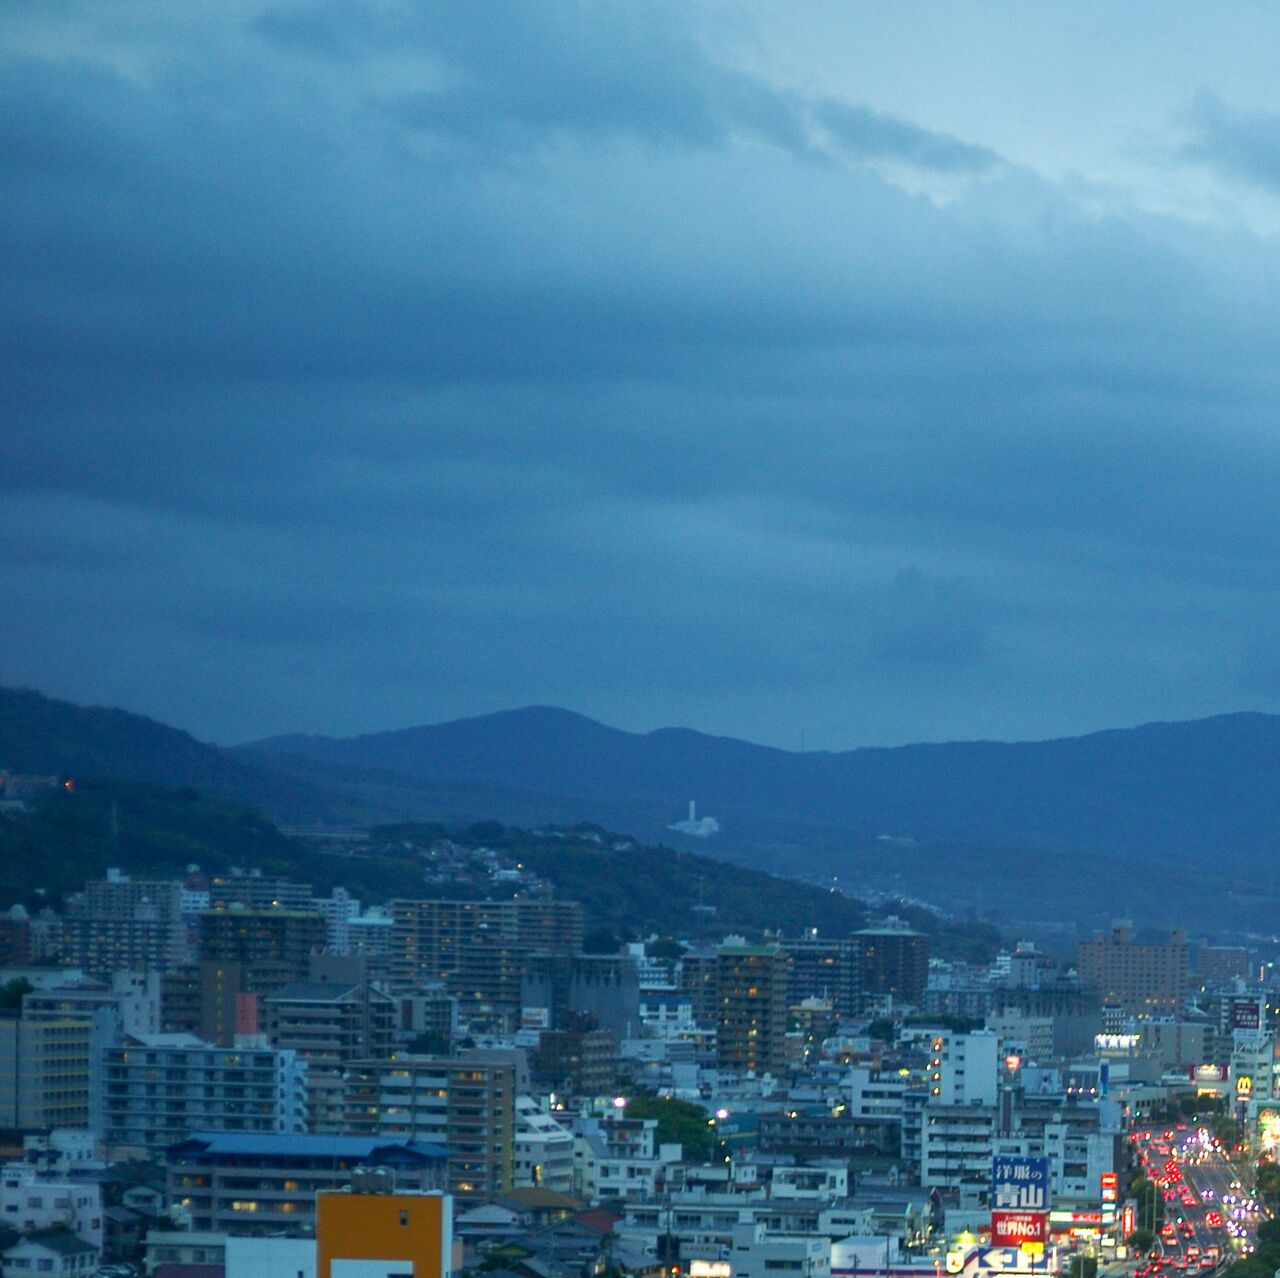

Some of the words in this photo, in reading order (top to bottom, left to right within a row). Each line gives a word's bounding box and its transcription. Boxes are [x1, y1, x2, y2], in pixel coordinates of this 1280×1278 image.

[996, 1164, 1043, 1180] 洋服の
[996, 1183, 1044, 1208] 青山
[996, 1220, 1041, 1237] 世界No.1
